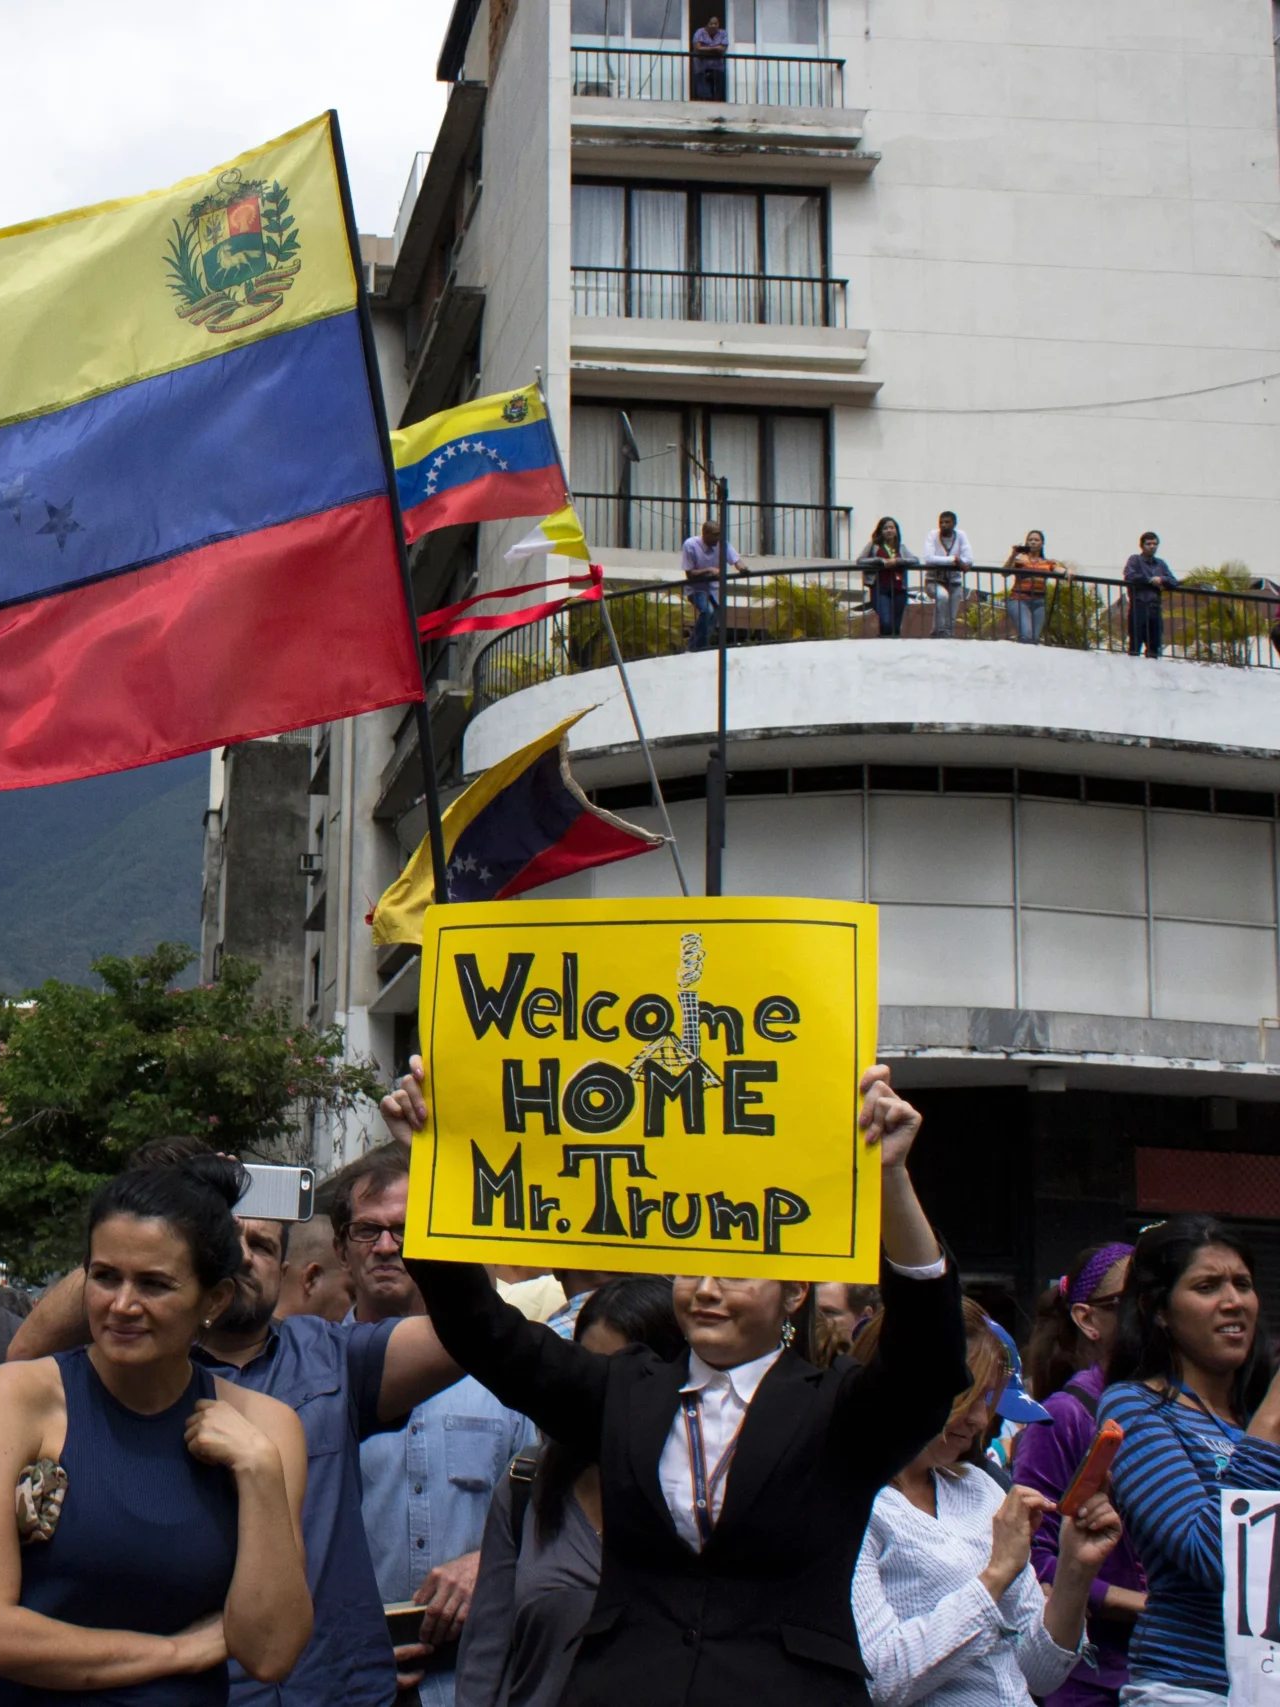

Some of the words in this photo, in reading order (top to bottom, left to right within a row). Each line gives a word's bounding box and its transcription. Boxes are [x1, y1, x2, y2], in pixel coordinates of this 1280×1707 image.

[455, 952, 801, 1056] Welcome
[502, 1058, 778, 1137] HOME
[471, 1139, 571, 1234] Mr.
[557, 1143, 812, 1254] Trump
